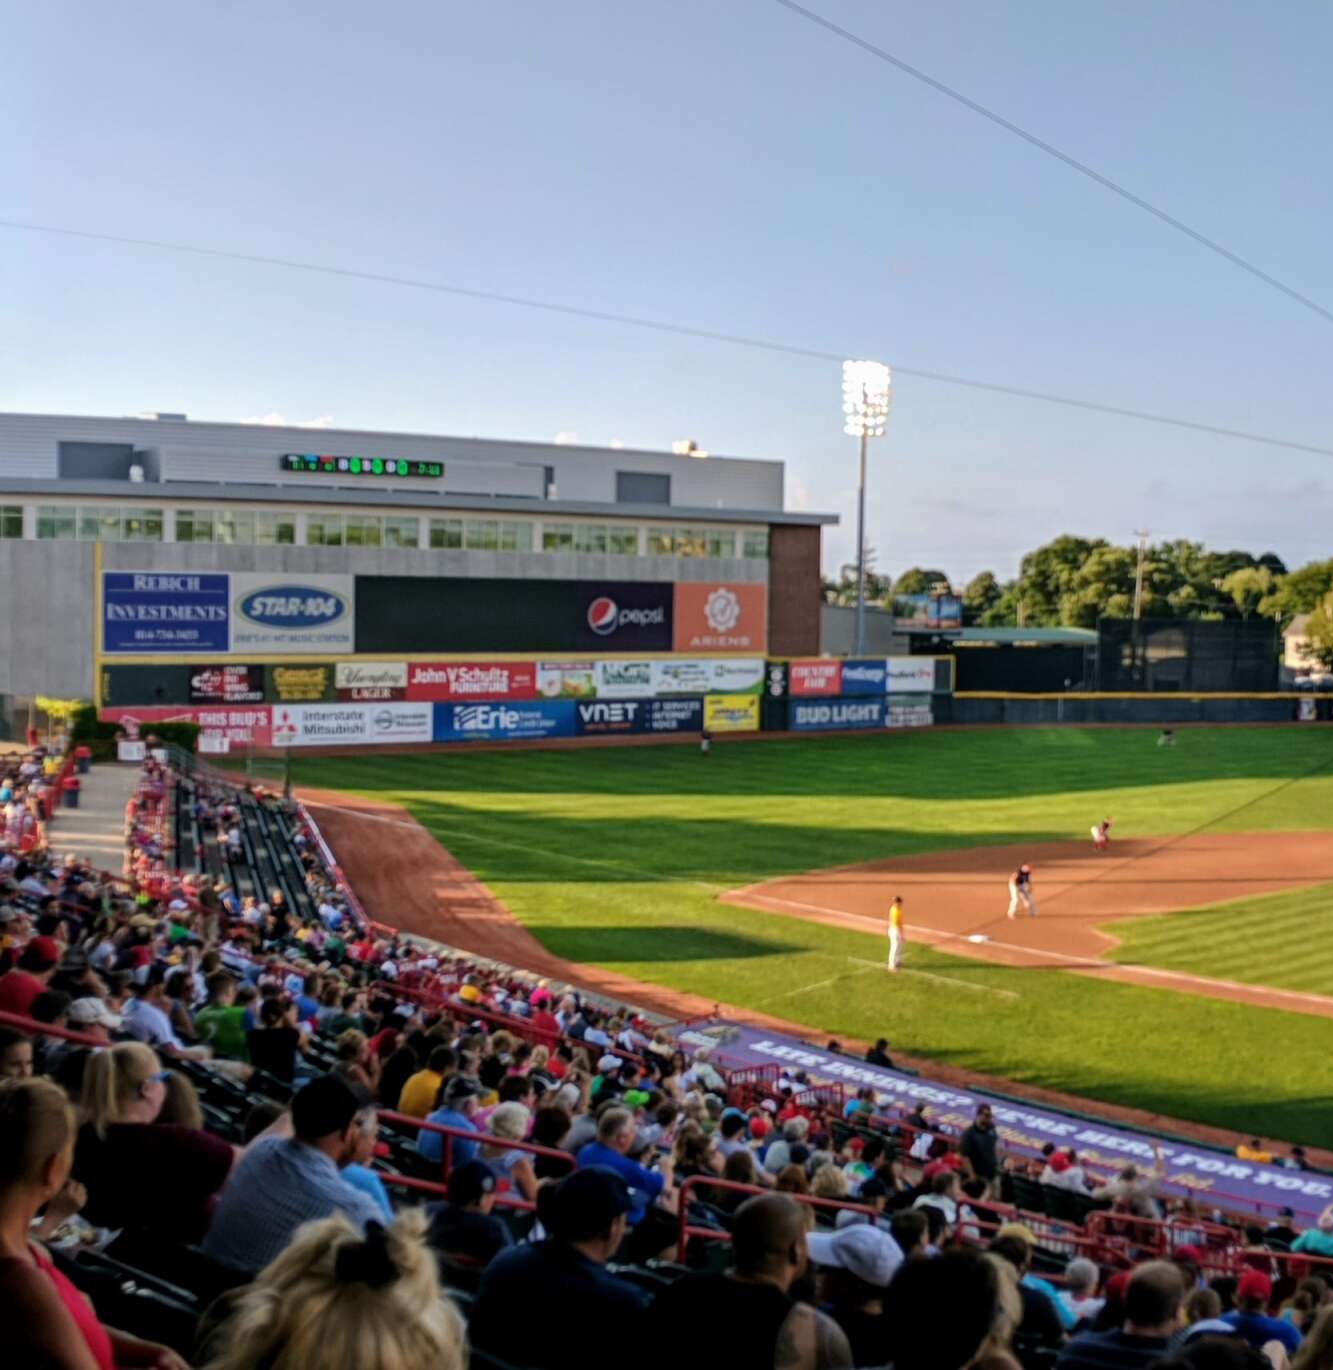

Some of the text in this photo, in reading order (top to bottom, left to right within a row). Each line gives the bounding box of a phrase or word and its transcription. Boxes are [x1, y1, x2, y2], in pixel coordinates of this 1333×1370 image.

[133, 574, 200, 591] REBICH
[107, 603, 227, 621] INVESTMENTS
[618, 606, 664, 626] pepsi
[411, 668, 447, 684] John
[457, 667, 509, 683] Schultz
[351, 688, 393, 699] LAGER
[450, 682, 509, 694] FURNITURE
[475, 706, 520, 730] Erie
[796, 706, 830, 724] BUD
[832, 704, 880, 722] LIGHT
[750, 1039, 829, 1068] LATE
[819, 1059, 974, 1107] INNINGS?
[1074, 1128, 1174, 1159] HERE
[1171, 1152, 1253, 1180] FOR
[1252, 1170, 1332, 1199] YOU.
